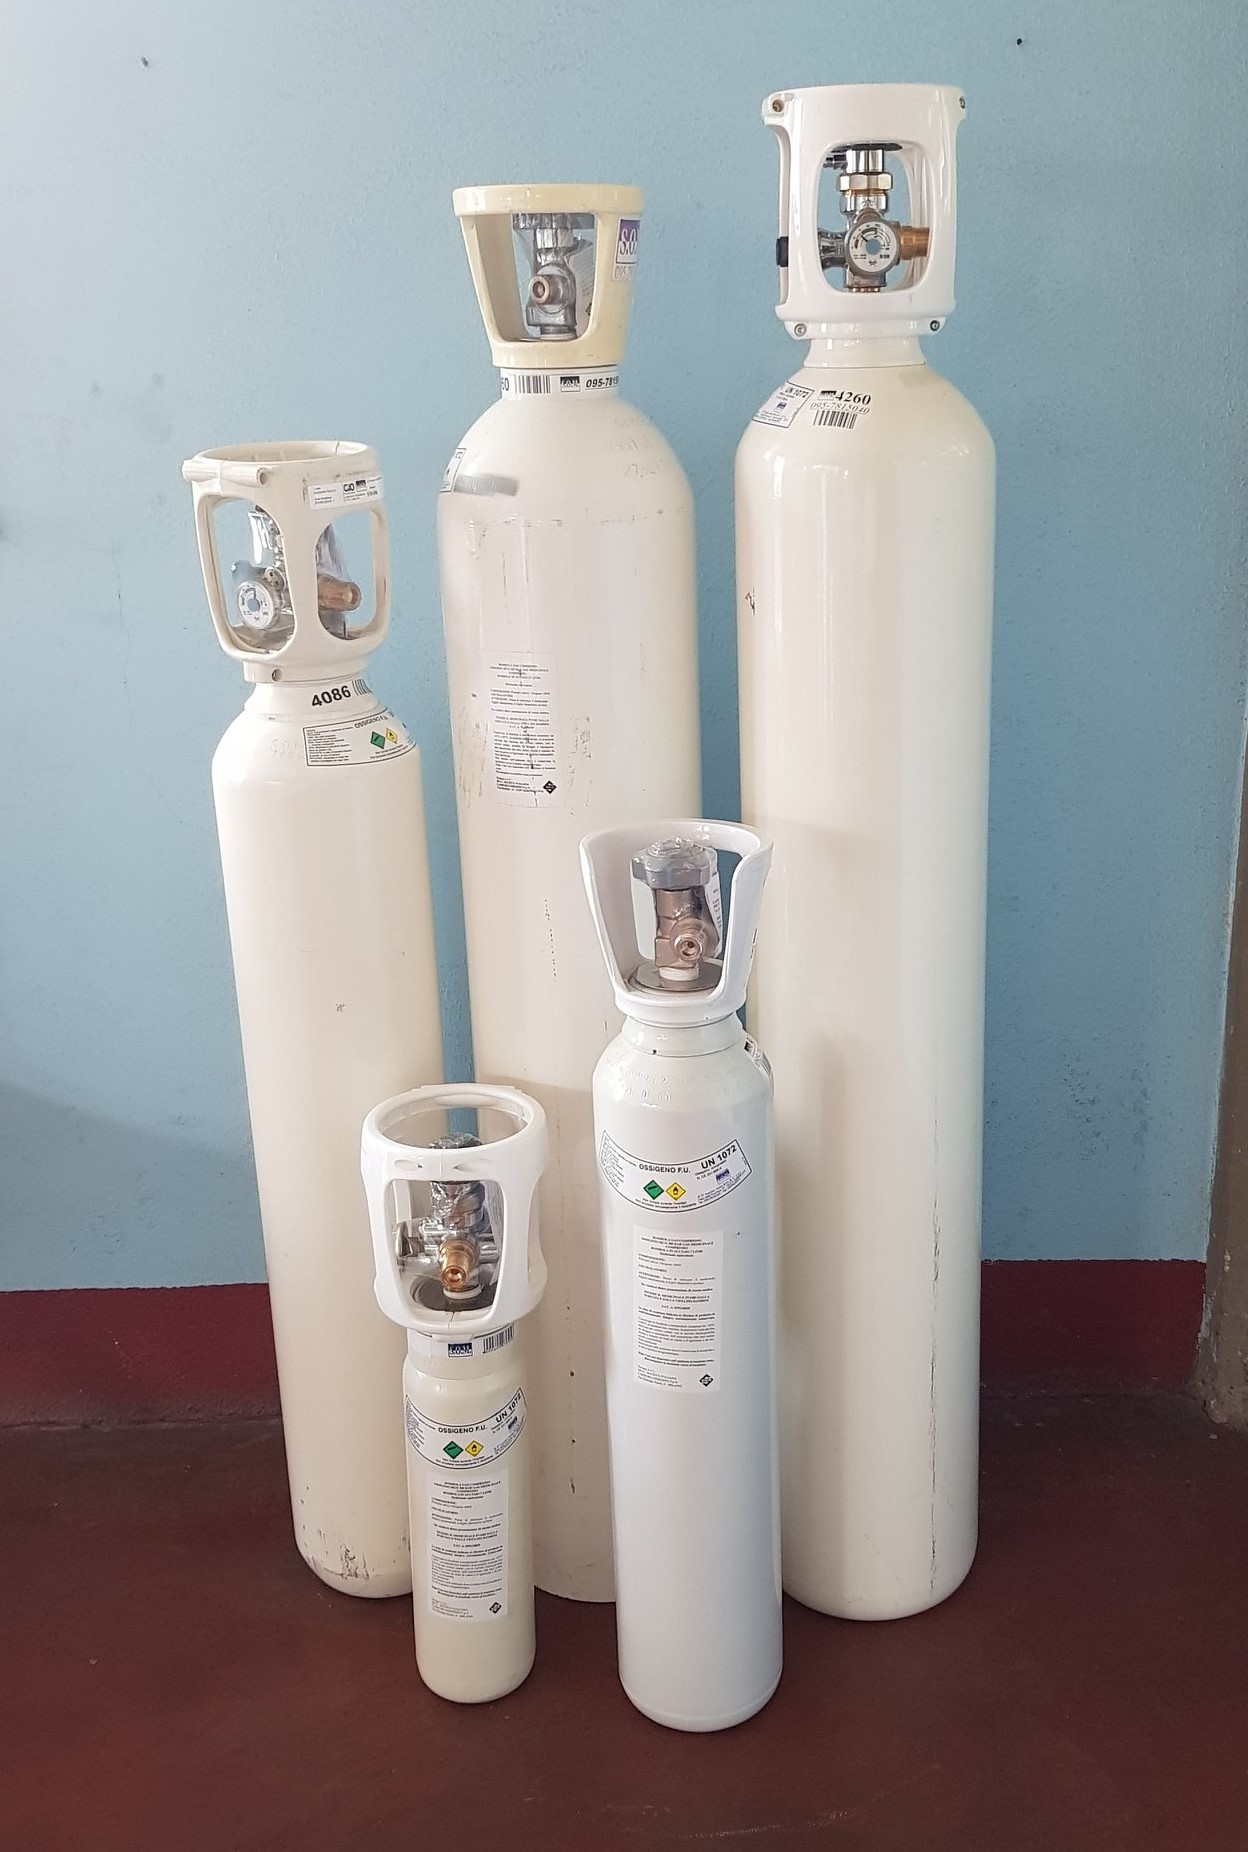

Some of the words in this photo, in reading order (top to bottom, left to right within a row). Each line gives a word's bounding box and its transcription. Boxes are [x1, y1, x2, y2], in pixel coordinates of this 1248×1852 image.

[835, 390, 872, 406] 4260
[810, 402, 870, 414] 095-7815040
[311, 685, 352, 707] 4086
[700, 1157, 716, 1169] UN
[717, 1144, 737, 1161] 1072
[639, 1163, 676, 1174] OSSIGENO
[677, 1166, 691, 1174] F.U.
[495, 1411, 508, 1423] UN
[508, 1392, 522, 1411] 1072
[475, 1424, 488, 1432] F.U.
